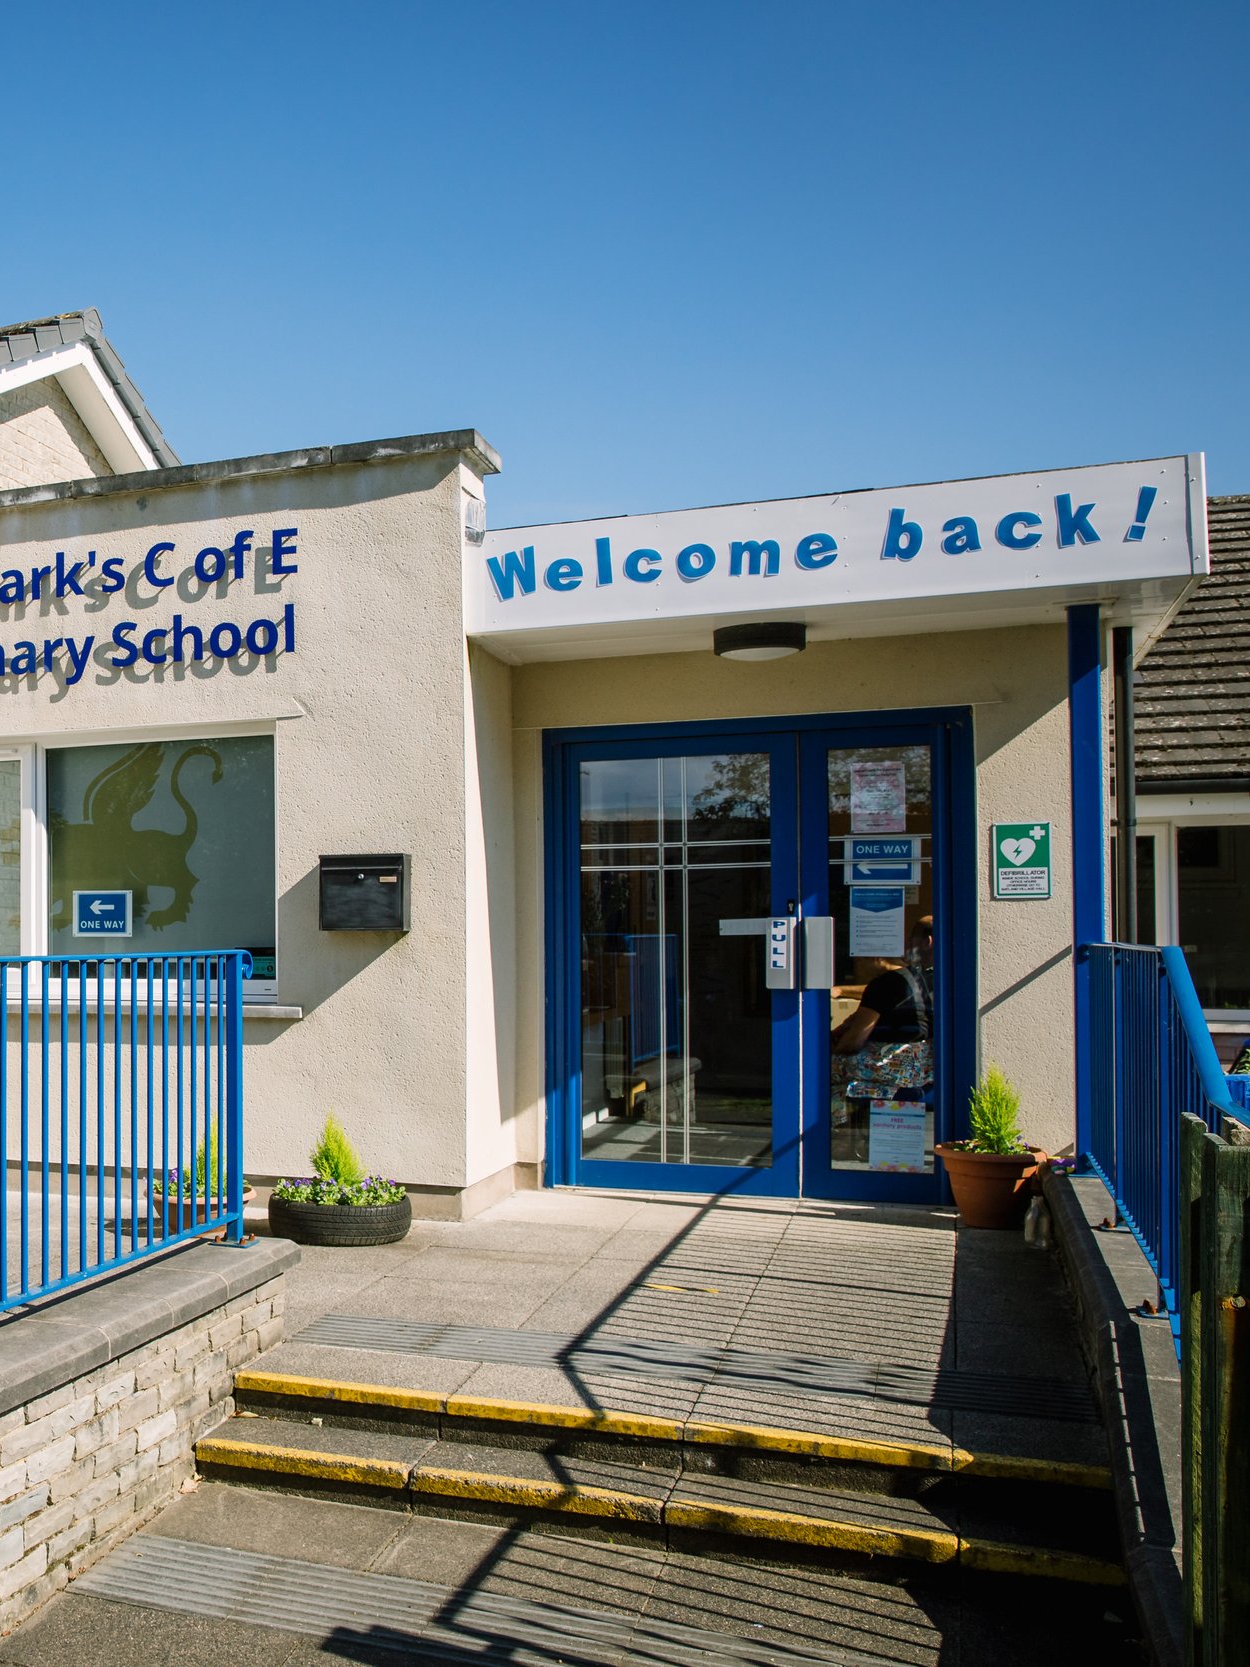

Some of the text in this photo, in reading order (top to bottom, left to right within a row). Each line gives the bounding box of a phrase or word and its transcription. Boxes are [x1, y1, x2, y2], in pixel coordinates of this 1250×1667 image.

[144, 541, 176, 588] C
[194, 530, 254, 585] of
[271, 527, 299, 576] E
[486, 532, 839, 602] Welcome
[110, 603, 296, 668] School
[856, 844, 909, 854] ONE WAY
[80, 920, 124, 929] ONE WAY
[772, 921, 786, 968] PULL
